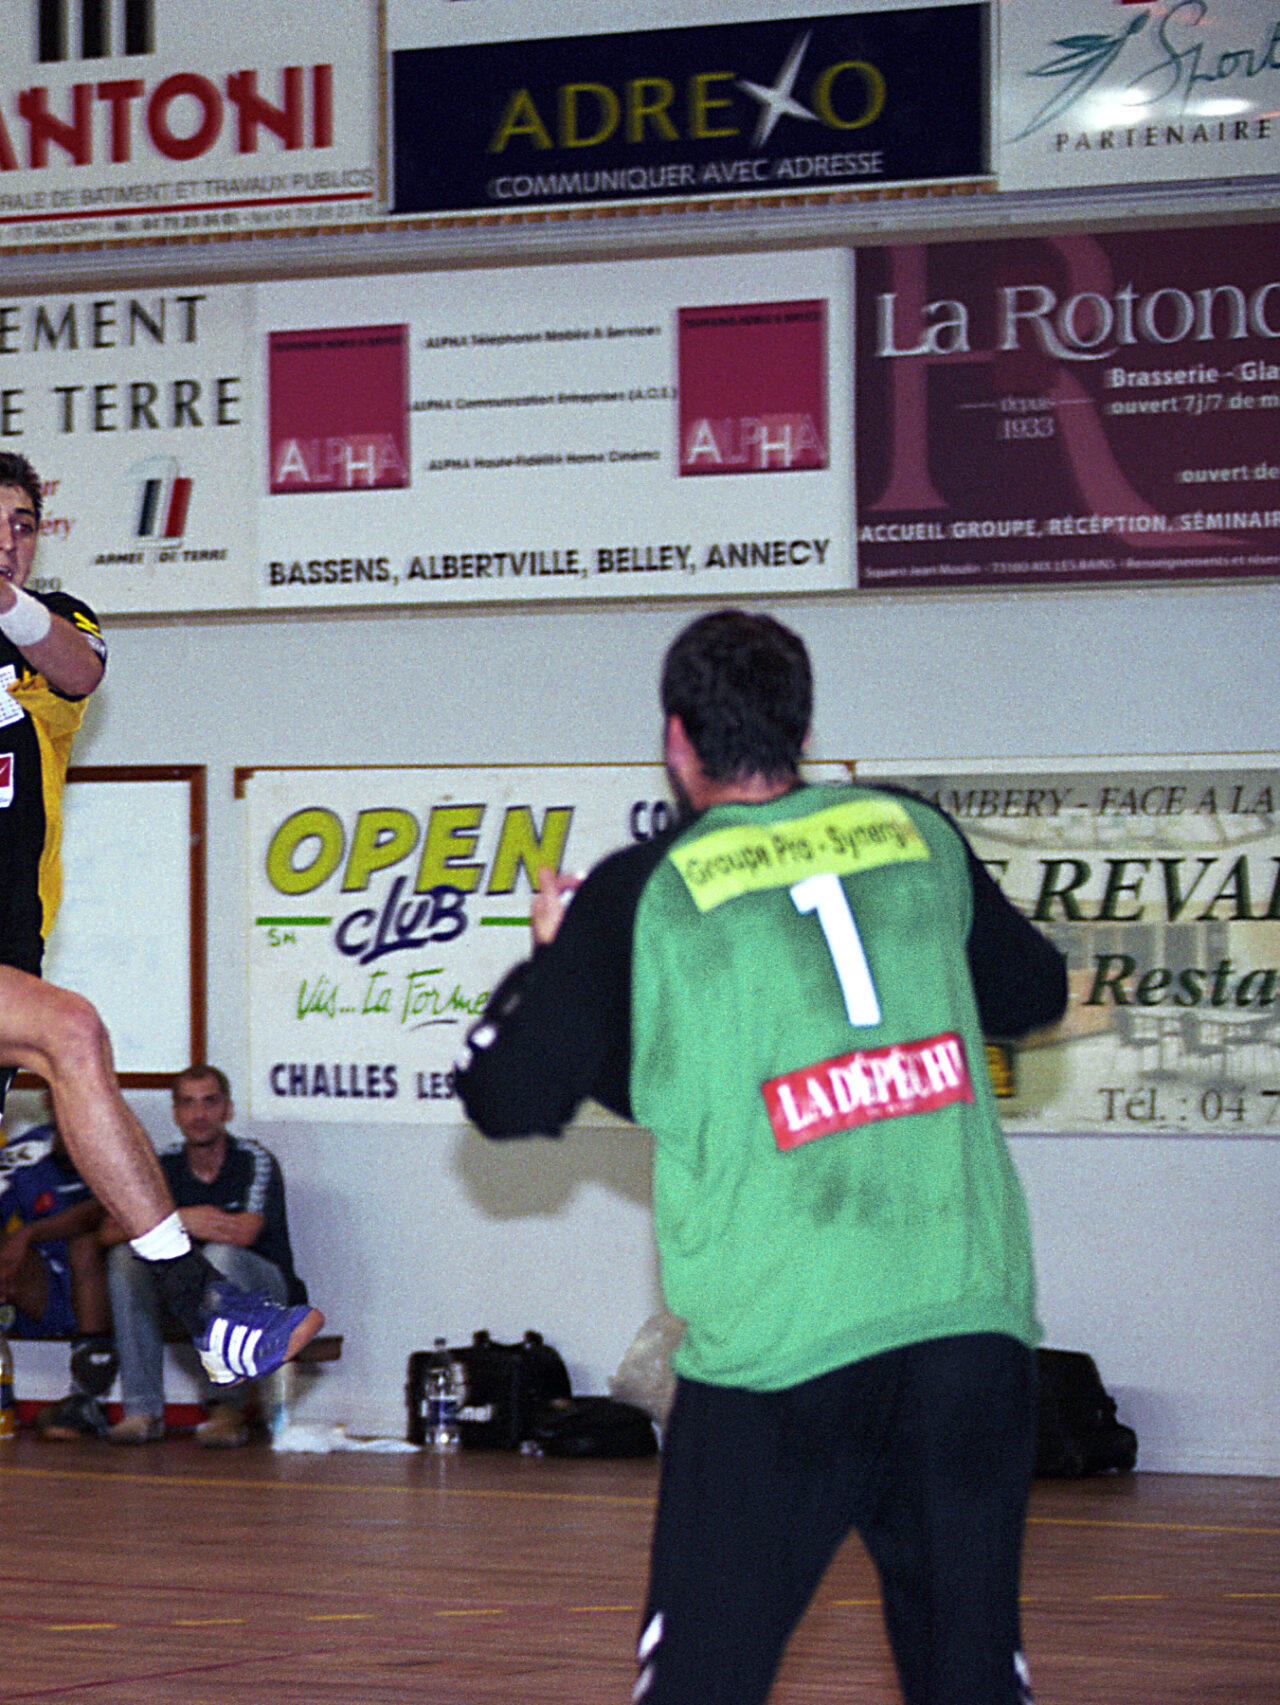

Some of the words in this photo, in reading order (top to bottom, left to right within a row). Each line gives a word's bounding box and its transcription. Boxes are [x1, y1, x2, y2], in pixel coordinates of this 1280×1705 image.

[1056, 119, 1271, 152] PARTENAIRE
[52, 188, 75, 207] DE
[177, 180, 198, 200] ET
[205, 174, 287, 196] TRAVAUX
[292, 167, 374, 191] PUBLICS
[494, 163, 697, 200] COMMUNIQUER
[703, 160, 770, 185] AVEC
[777, 151, 886, 179] ADRESSE
[426, 337, 469, 349] ALPHA
[607, 325, 661, 339] Services
[874, 292, 971, 358] La
[1110, 362, 1219, 389] Brasserie
[53, 377, 243, 434] TERRE
[1110, 397, 1177, 415] ouvert
[1184, 393, 1222, 415] 7j/7
[1230, 393, 1255, 409] de
[684, 413, 828, 470] ALPHA
[1003, 417, 1055, 439] 1933
[275, 433, 409, 488] ALPHA
[428, 458, 470, 471] ALPHA
[1181, 465, 1248, 483] ouvert
[1253, 461, 1280, 480] de
[860, 523, 945, 542] ACCUEIL
[952, 519, 1044, 539] GROUPE,
[182, 548, 228, 562] TERRE
[268, 554, 399, 588] BASSENS,
[406, 547, 589, 583] ALBERTVILLE,
[596, 541, 697, 575] BELLEY,
[705, 538, 831, 571] ANNECY
[1097, 785, 1186, 817] FACE
[1196, 785, 1218, 815] A
[1231, 784, 1274, 814] LA
[265, 802, 576, 897] OPEN
[685, 845, 770, 887] Groupe
[772, 834, 814, 866] Pro
[789, 872, 882, 1028] 1
[401, 967, 490, 1025] Forme
[1082, 952, 1280, 1008] Resta
[269, 1063, 399, 1099] CHALLES
[418, 1071, 455, 1100] LES
[777, 1077, 834, 1132] LA
[1099, 1087, 1166, 1122] Tél.
[1200, 1093, 1247, 1122] 04
